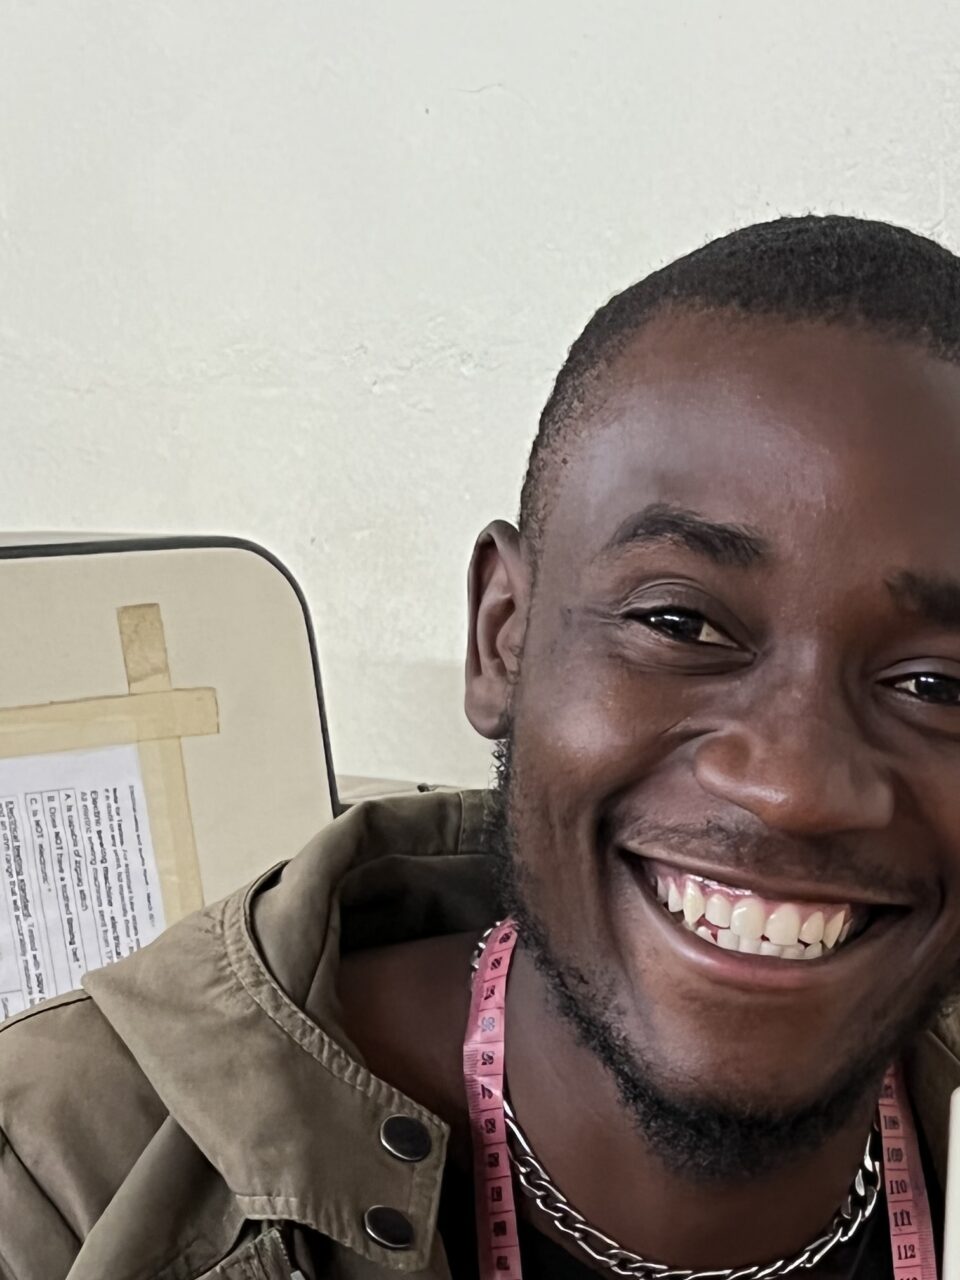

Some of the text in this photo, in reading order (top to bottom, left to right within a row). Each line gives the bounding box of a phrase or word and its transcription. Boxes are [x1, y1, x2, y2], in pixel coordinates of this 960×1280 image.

[889, 1178, 908, 1195] 110
[893, 1209, 912, 1227] 111
[897, 1244, 916, 1260] 112
